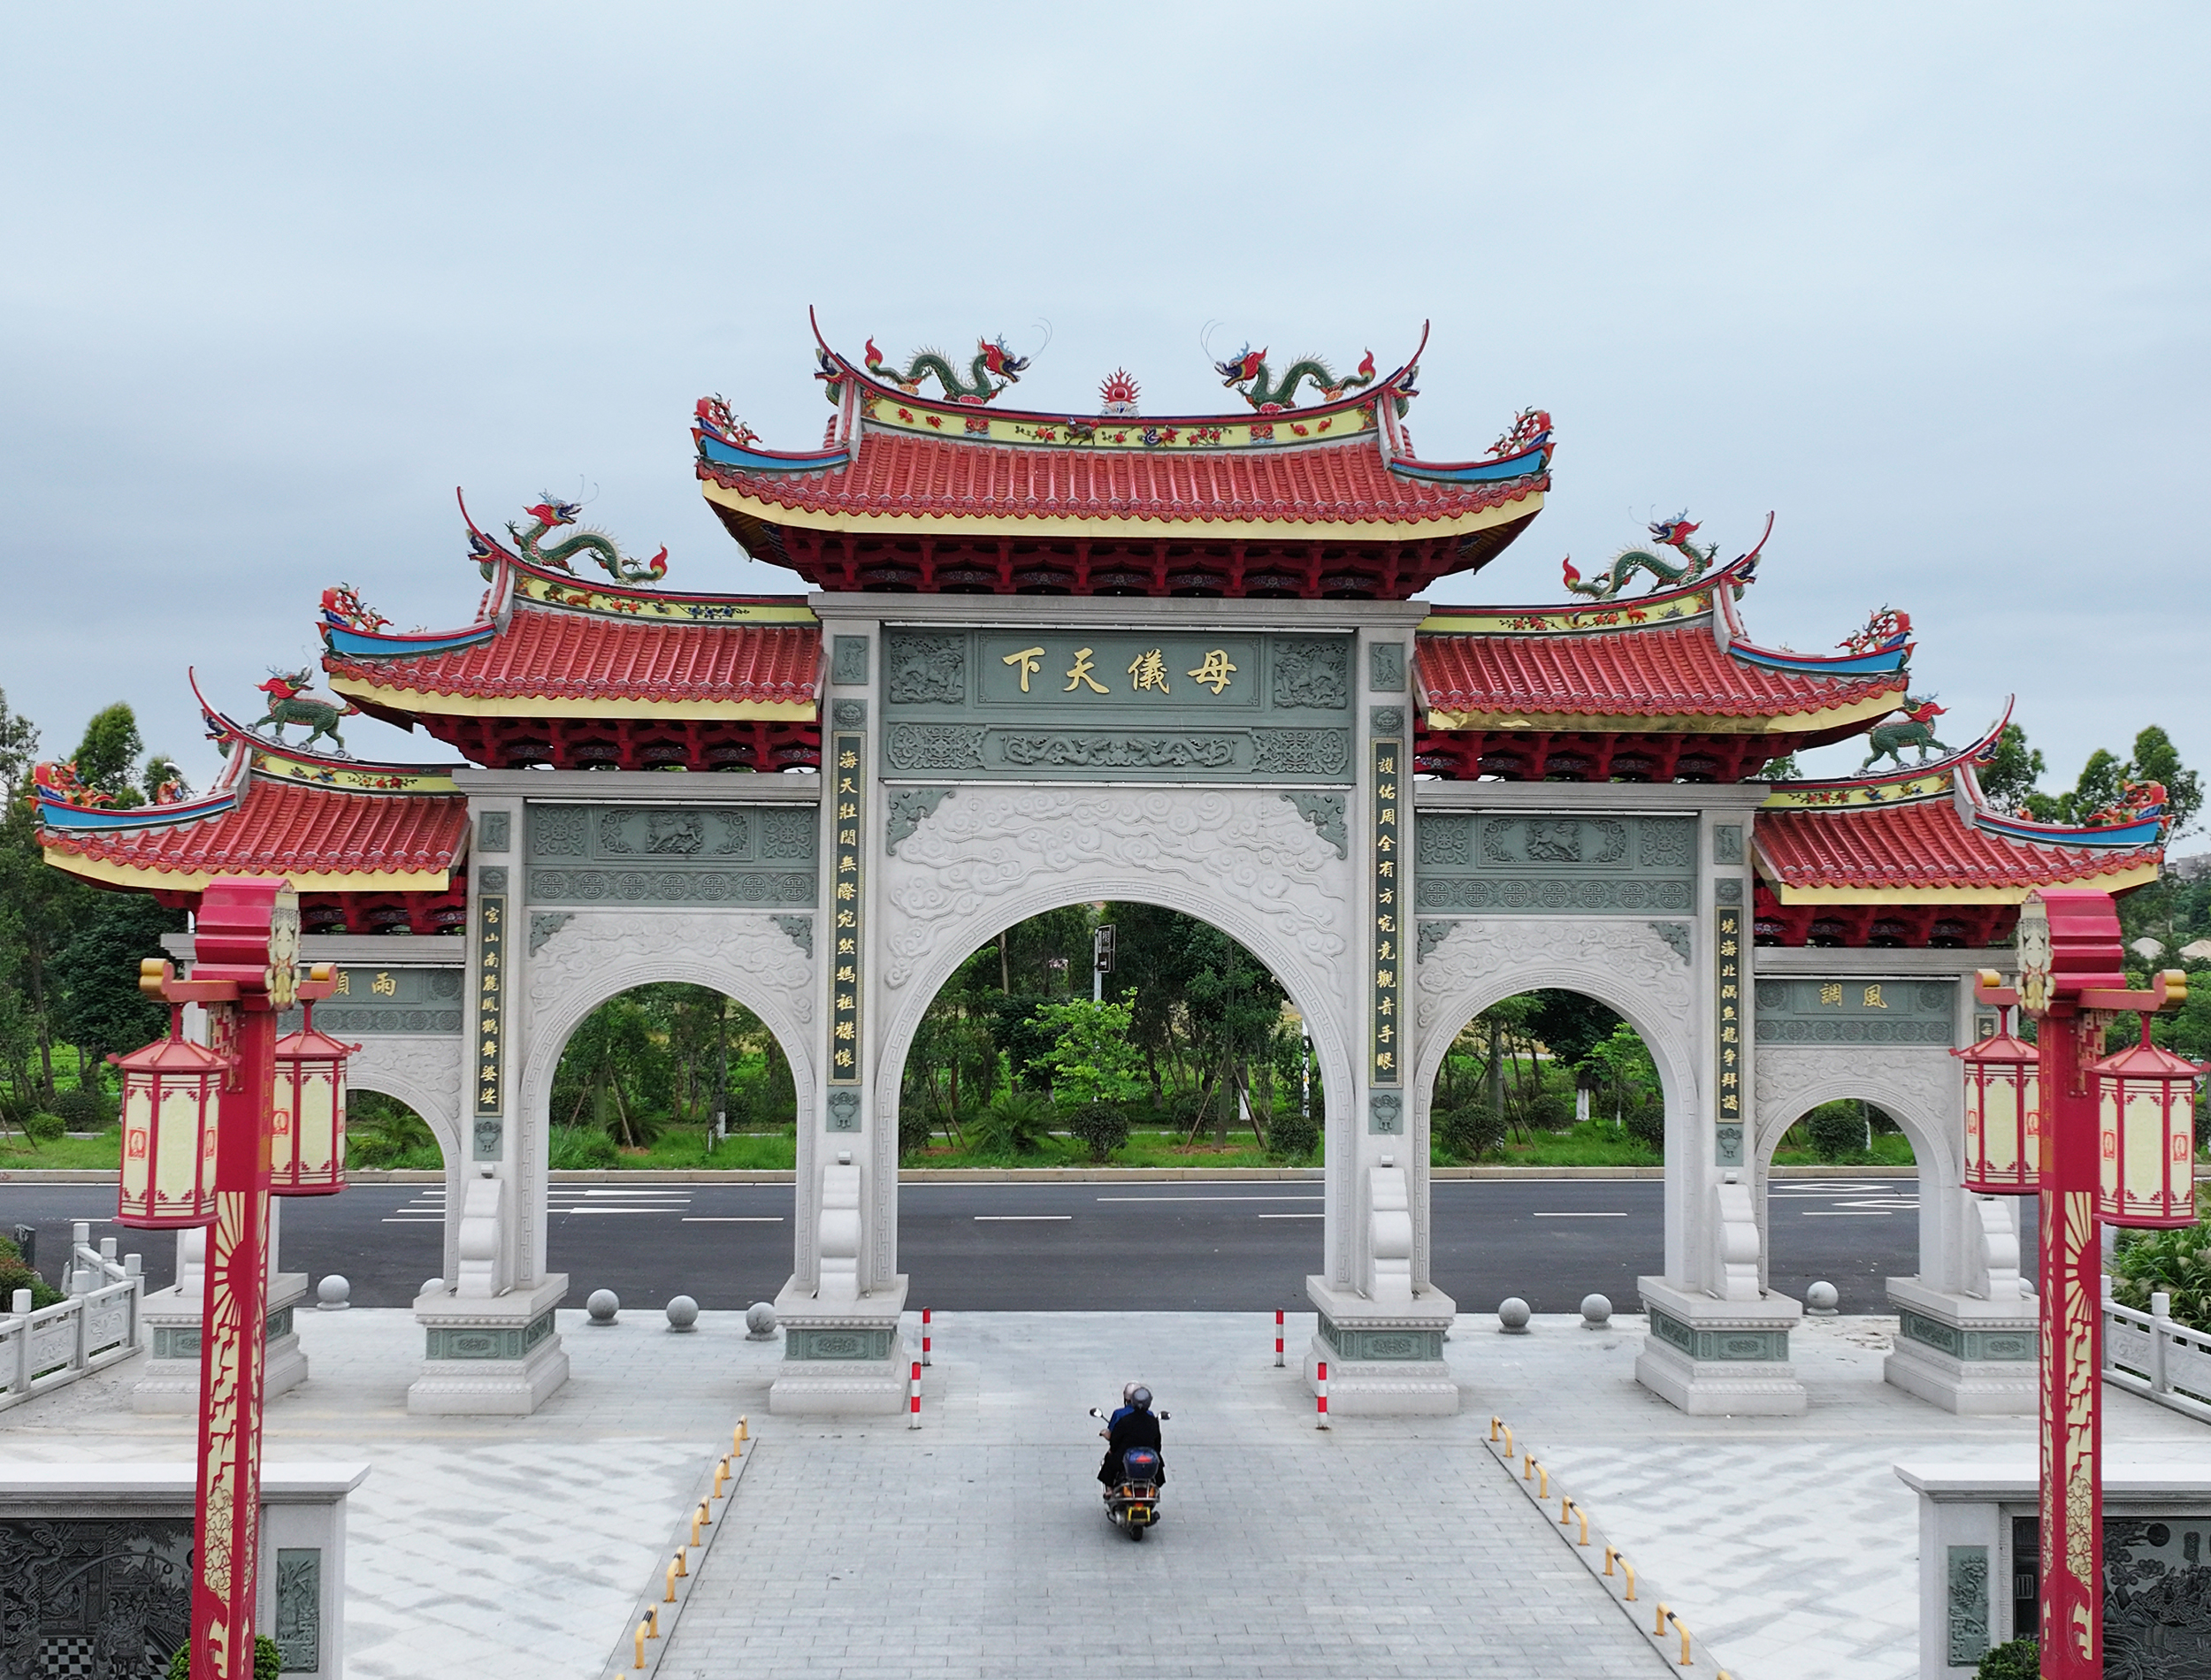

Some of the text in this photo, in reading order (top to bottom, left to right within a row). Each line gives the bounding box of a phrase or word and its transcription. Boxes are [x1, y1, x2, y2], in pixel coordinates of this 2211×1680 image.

[1001, 645, 1238, 695] 母儀天下
[1818, 982, 1888, 1009] 風調
